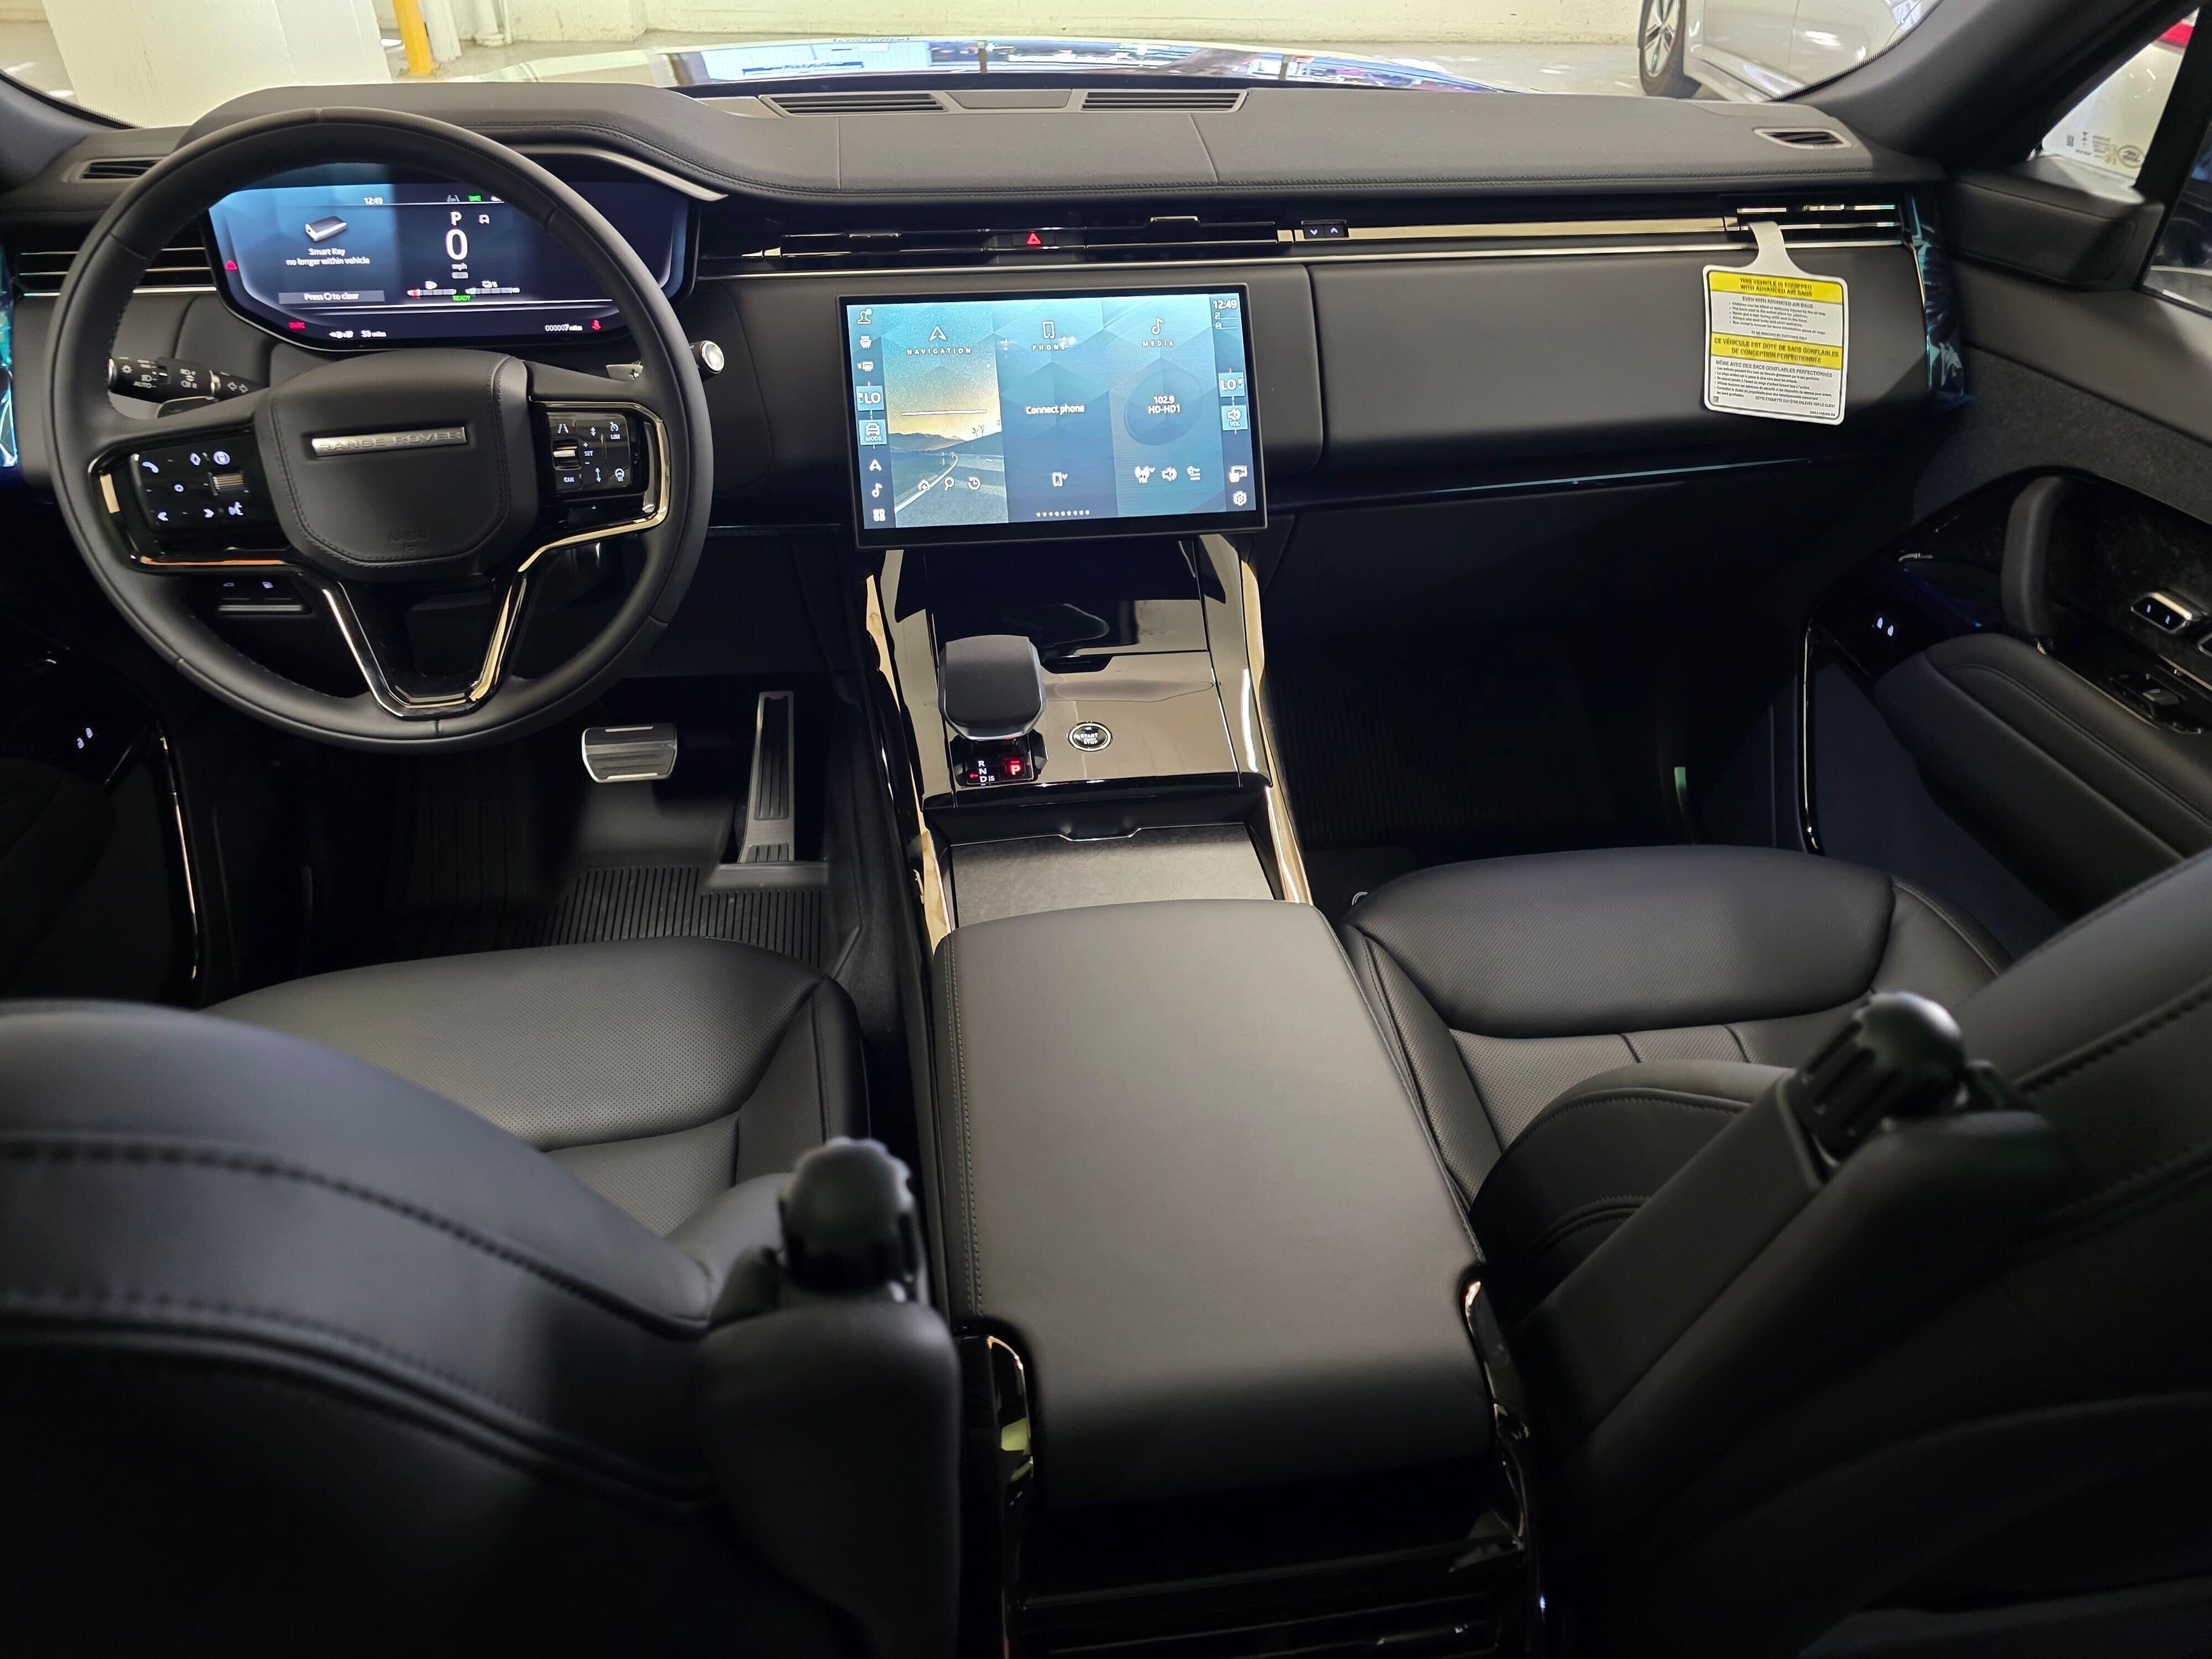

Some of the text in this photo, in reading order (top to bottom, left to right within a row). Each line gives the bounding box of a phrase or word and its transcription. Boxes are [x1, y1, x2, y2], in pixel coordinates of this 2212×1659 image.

[450, 211, 462, 226] P
[446, 229, 468, 260] 0
[332, 248, 346, 257] Key
[298, 258, 321, 267] longer
[321, 257, 344, 265] within
[344, 256, 371, 264] vehicle
[451, 263, 468, 271] mph
[1755, 285, 1785, 294] ADVANCED
[342, 292, 359, 300] clear
[1212, 299, 1238, 310] 12:49
[906, 347, 972, 356] NAVIGATION
[1723, 336, 1750, 347] VÉHICULE
[1762, 342, 1777, 351] DOTÉ
[1787, 345, 1802, 353] SACS
[1803, 347, 1839, 358] GONFLABLES
[1740, 348, 1776, 358] CONCEPTION
[1777, 352, 1822, 363] PERFECTIONNÉE
[1220, 378, 1237, 391] LO
[864, 391, 881, 404] LO
[1153, 395, 1175, 405] 102.9
[1025, 404, 1085, 416] Connect phone
[1147, 404, 1181, 414] HD-HD1
[319, 431, 462, 452] RANGE ROVER
[1010, 764, 1021, 775] P
